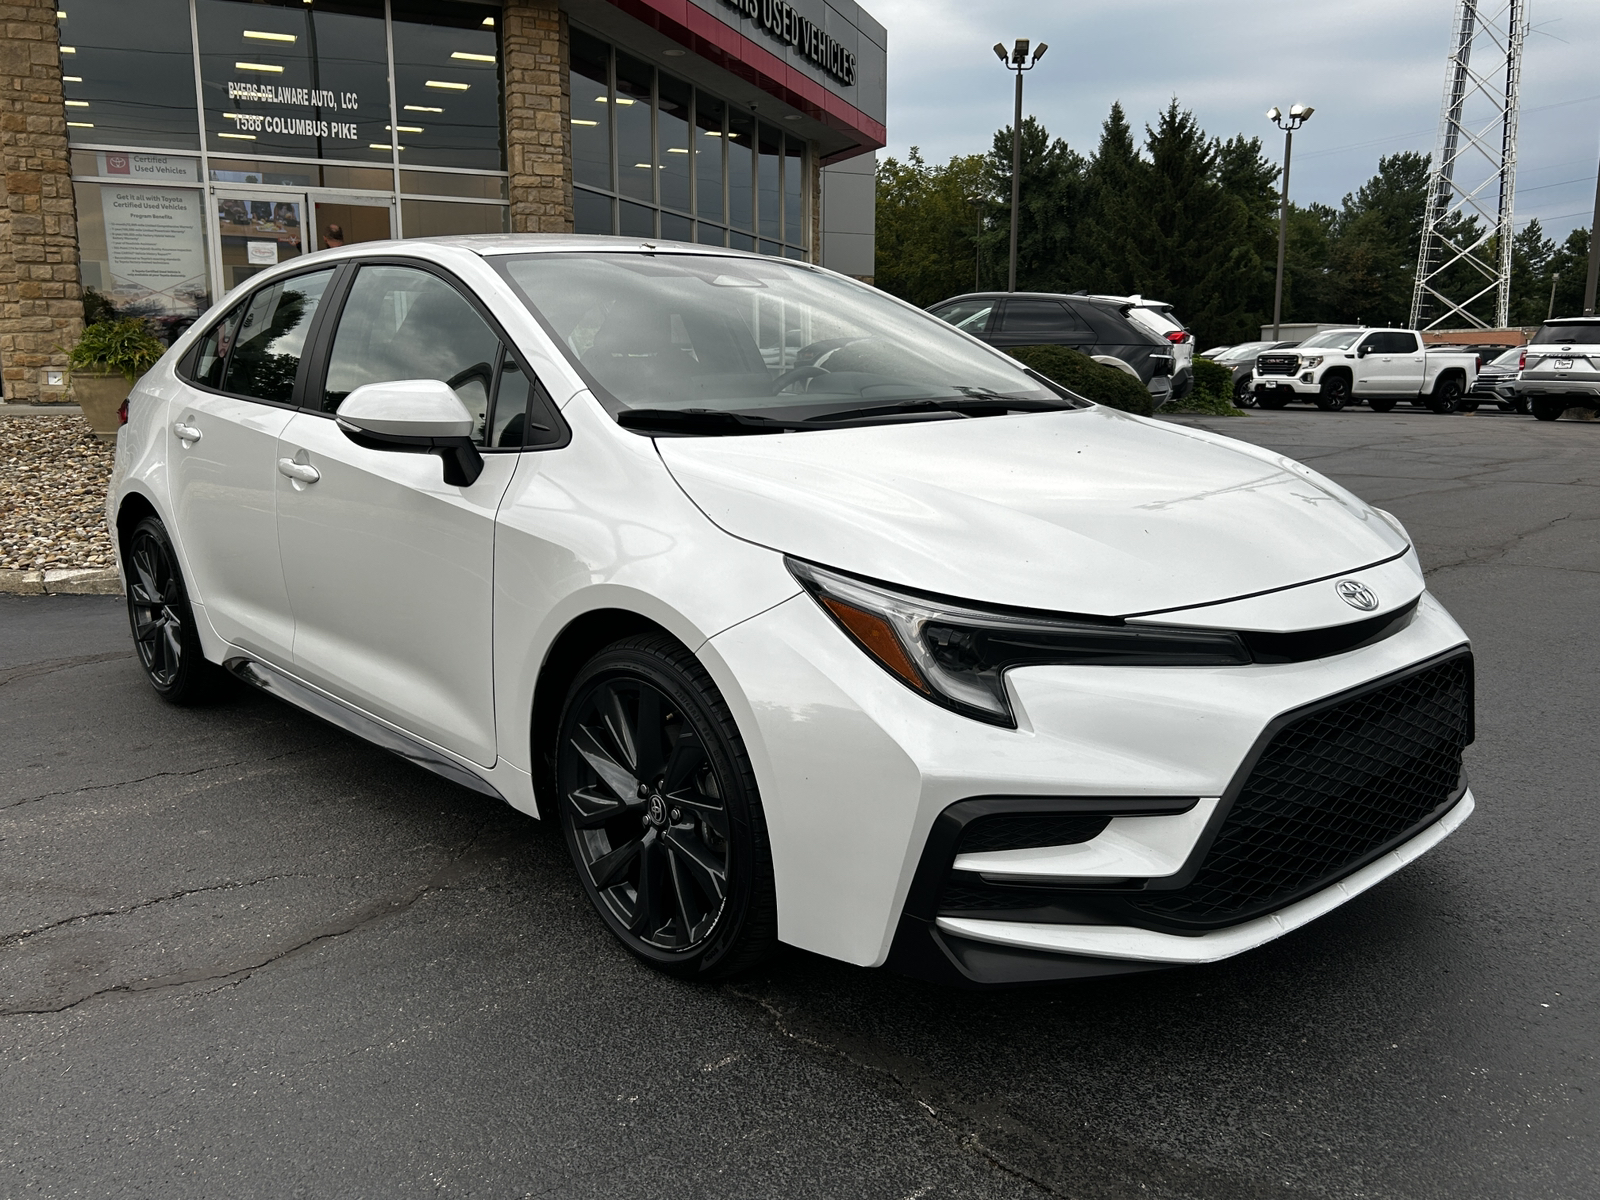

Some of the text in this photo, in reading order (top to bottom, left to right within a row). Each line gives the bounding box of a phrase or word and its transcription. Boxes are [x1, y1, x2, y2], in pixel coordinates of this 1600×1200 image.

[762, 0, 856, 86] USED VEHICLES
[228, 82, 358, 112] BYERS DELAWARE AUTO, LCC
[234, 114, 358, 140] 1588 COLUMBUS PIKE
[133, 155, 167, 164] Certified
[134, 165, 187, 174] Used Vehicles
[113, 201, 142, 209] Certified
